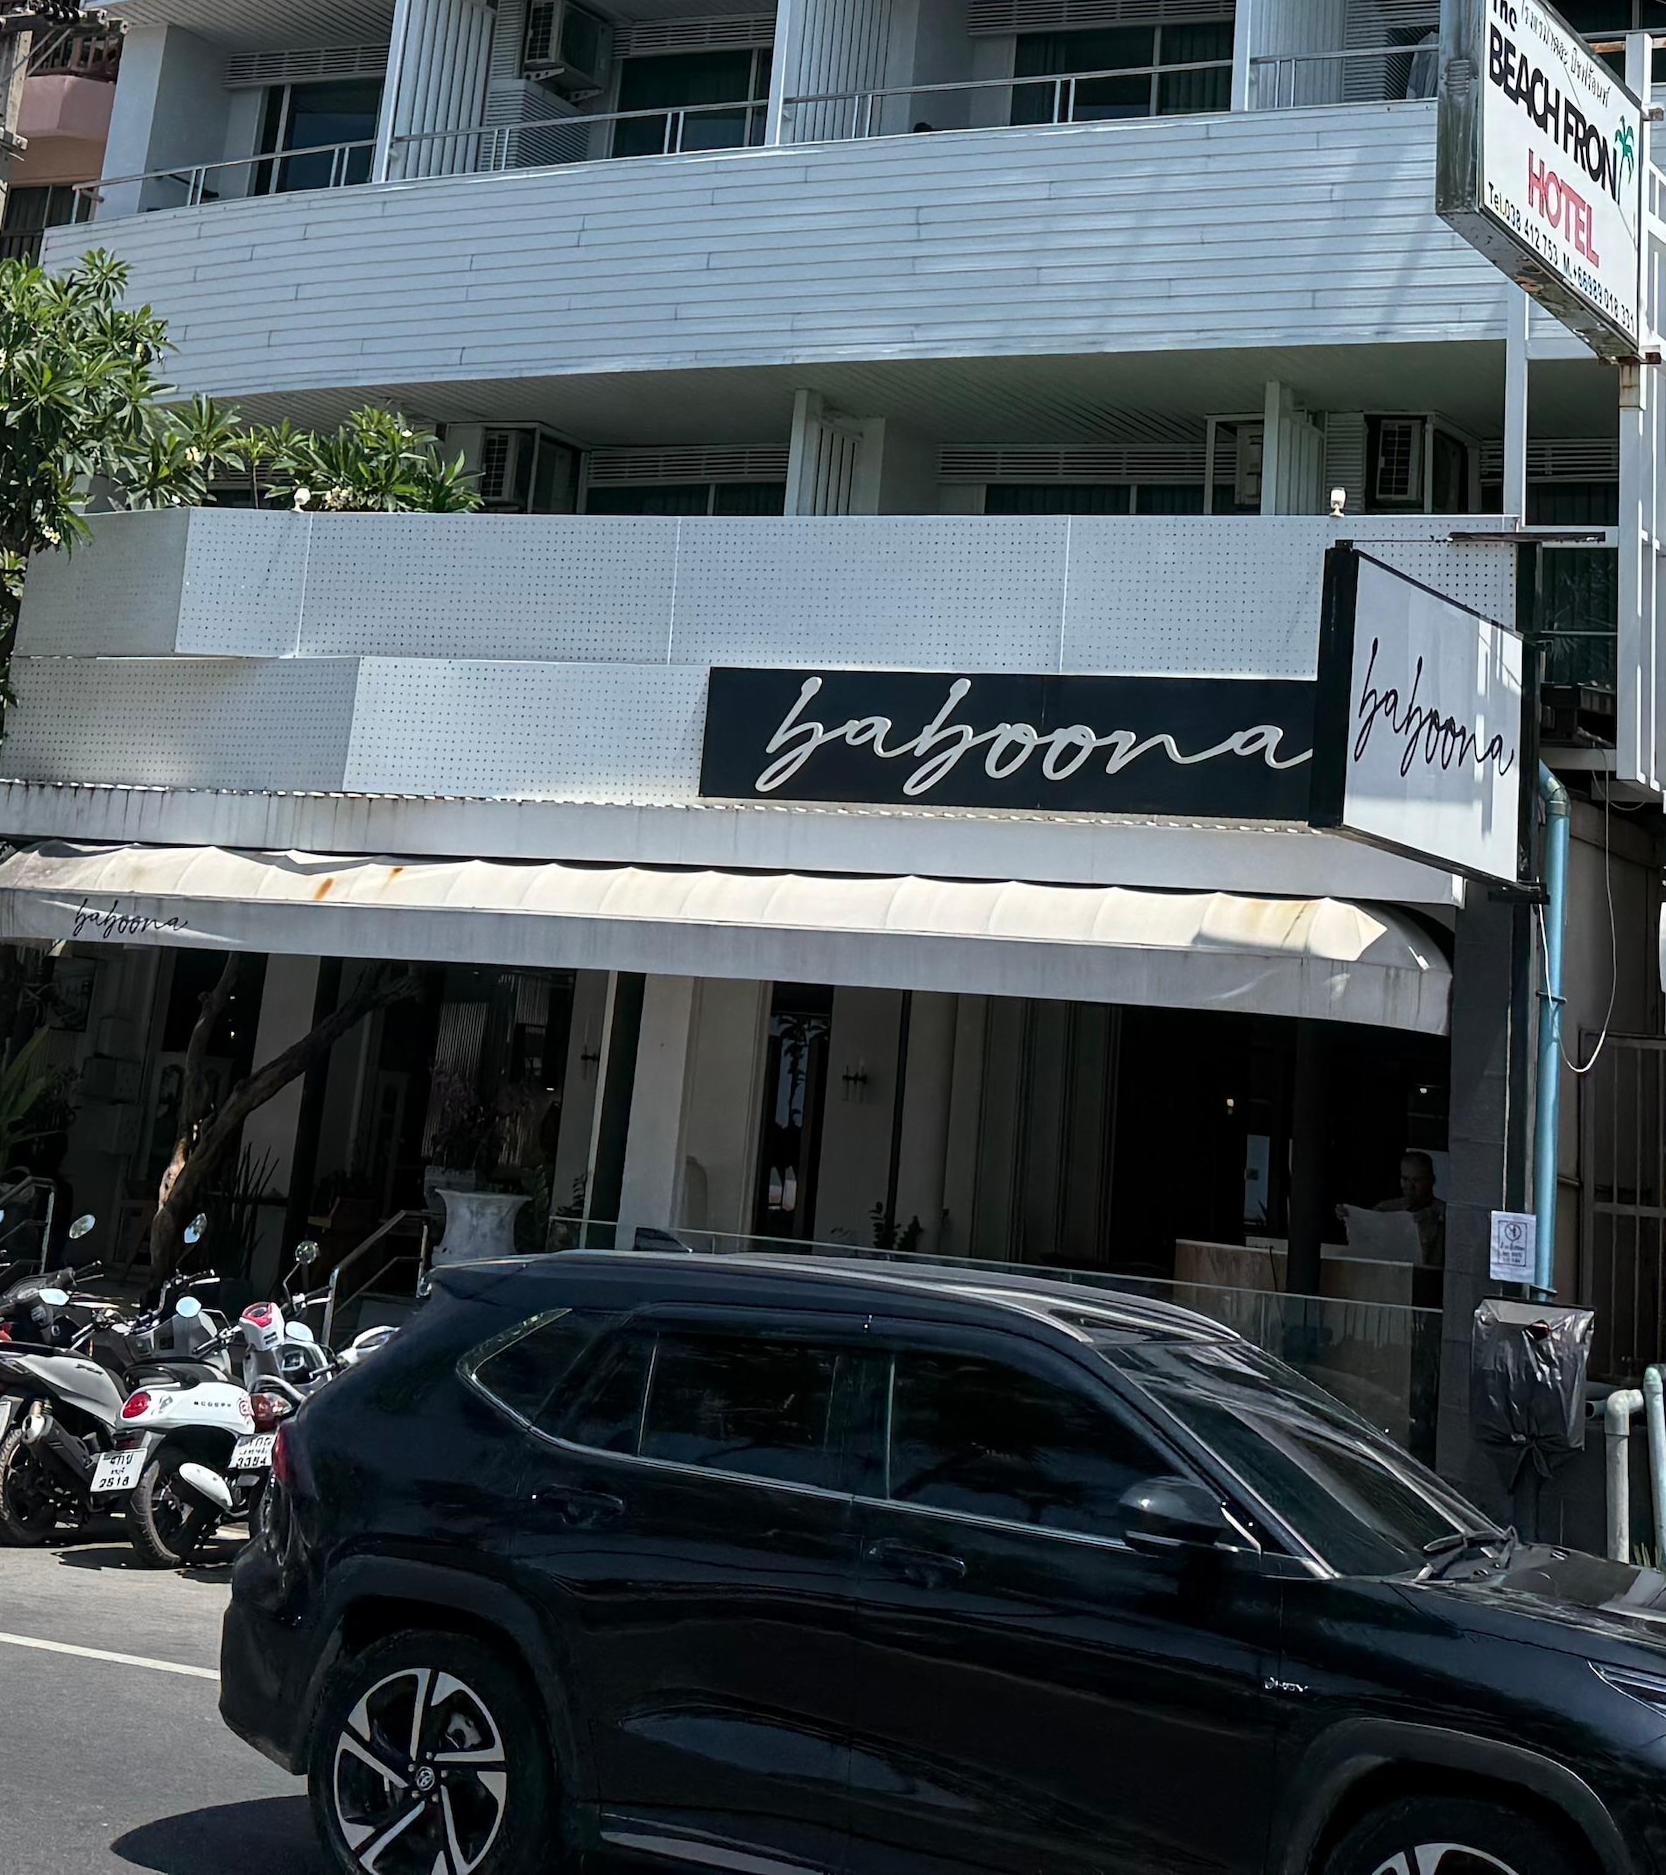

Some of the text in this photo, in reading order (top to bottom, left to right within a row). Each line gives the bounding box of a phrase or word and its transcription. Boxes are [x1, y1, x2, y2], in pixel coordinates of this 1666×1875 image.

[1490, 21, 1560, 145] BEACH
[1524, 218, 1540, 250] 412
[1542, 234, 1559, 266] 753
[1528, 147, 1600, 269] HOTEL
[755, 676, 1313, 795] baboona
[1352, 638, 1515, 778] baboona
[73, 897, 189, 938] baboona
